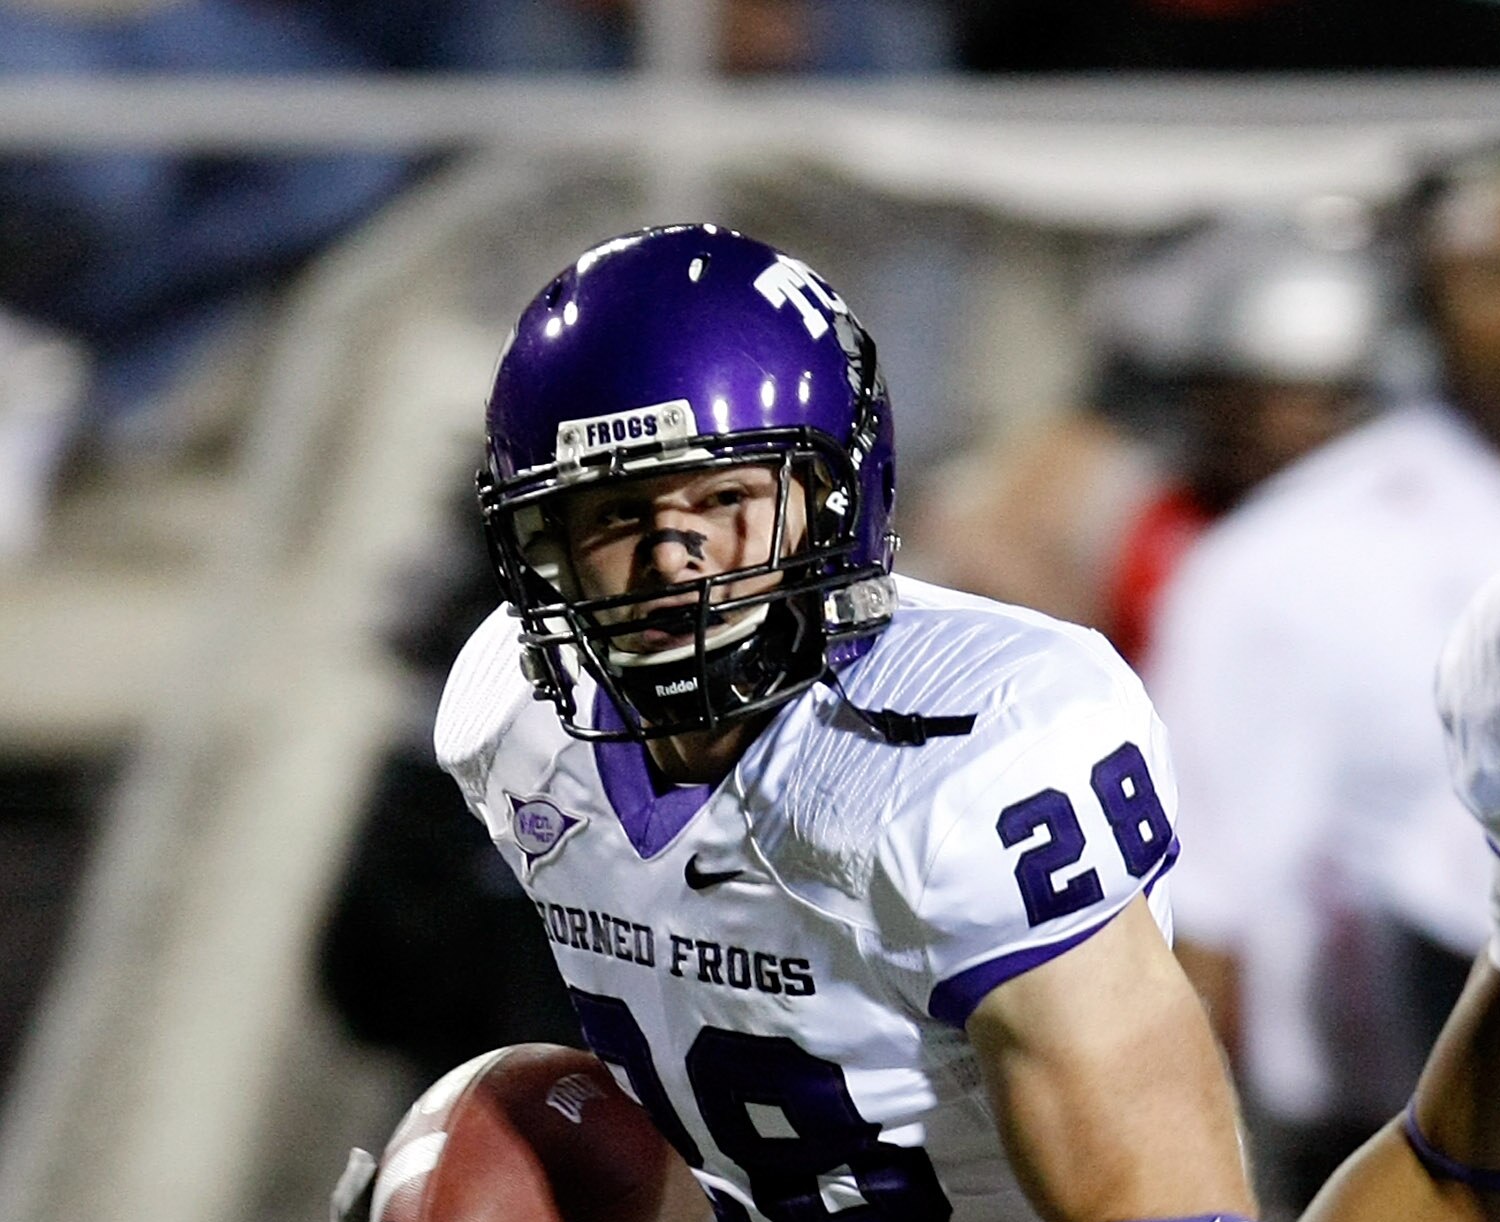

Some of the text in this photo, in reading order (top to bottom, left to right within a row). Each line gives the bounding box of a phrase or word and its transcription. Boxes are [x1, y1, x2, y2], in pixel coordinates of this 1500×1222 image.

[753, 254, 849, 340] TC
[585, 414, 658, 448] FROGS
[995, 741, 1173, 928] 28
[669, 934, 816, 997] FROGS
